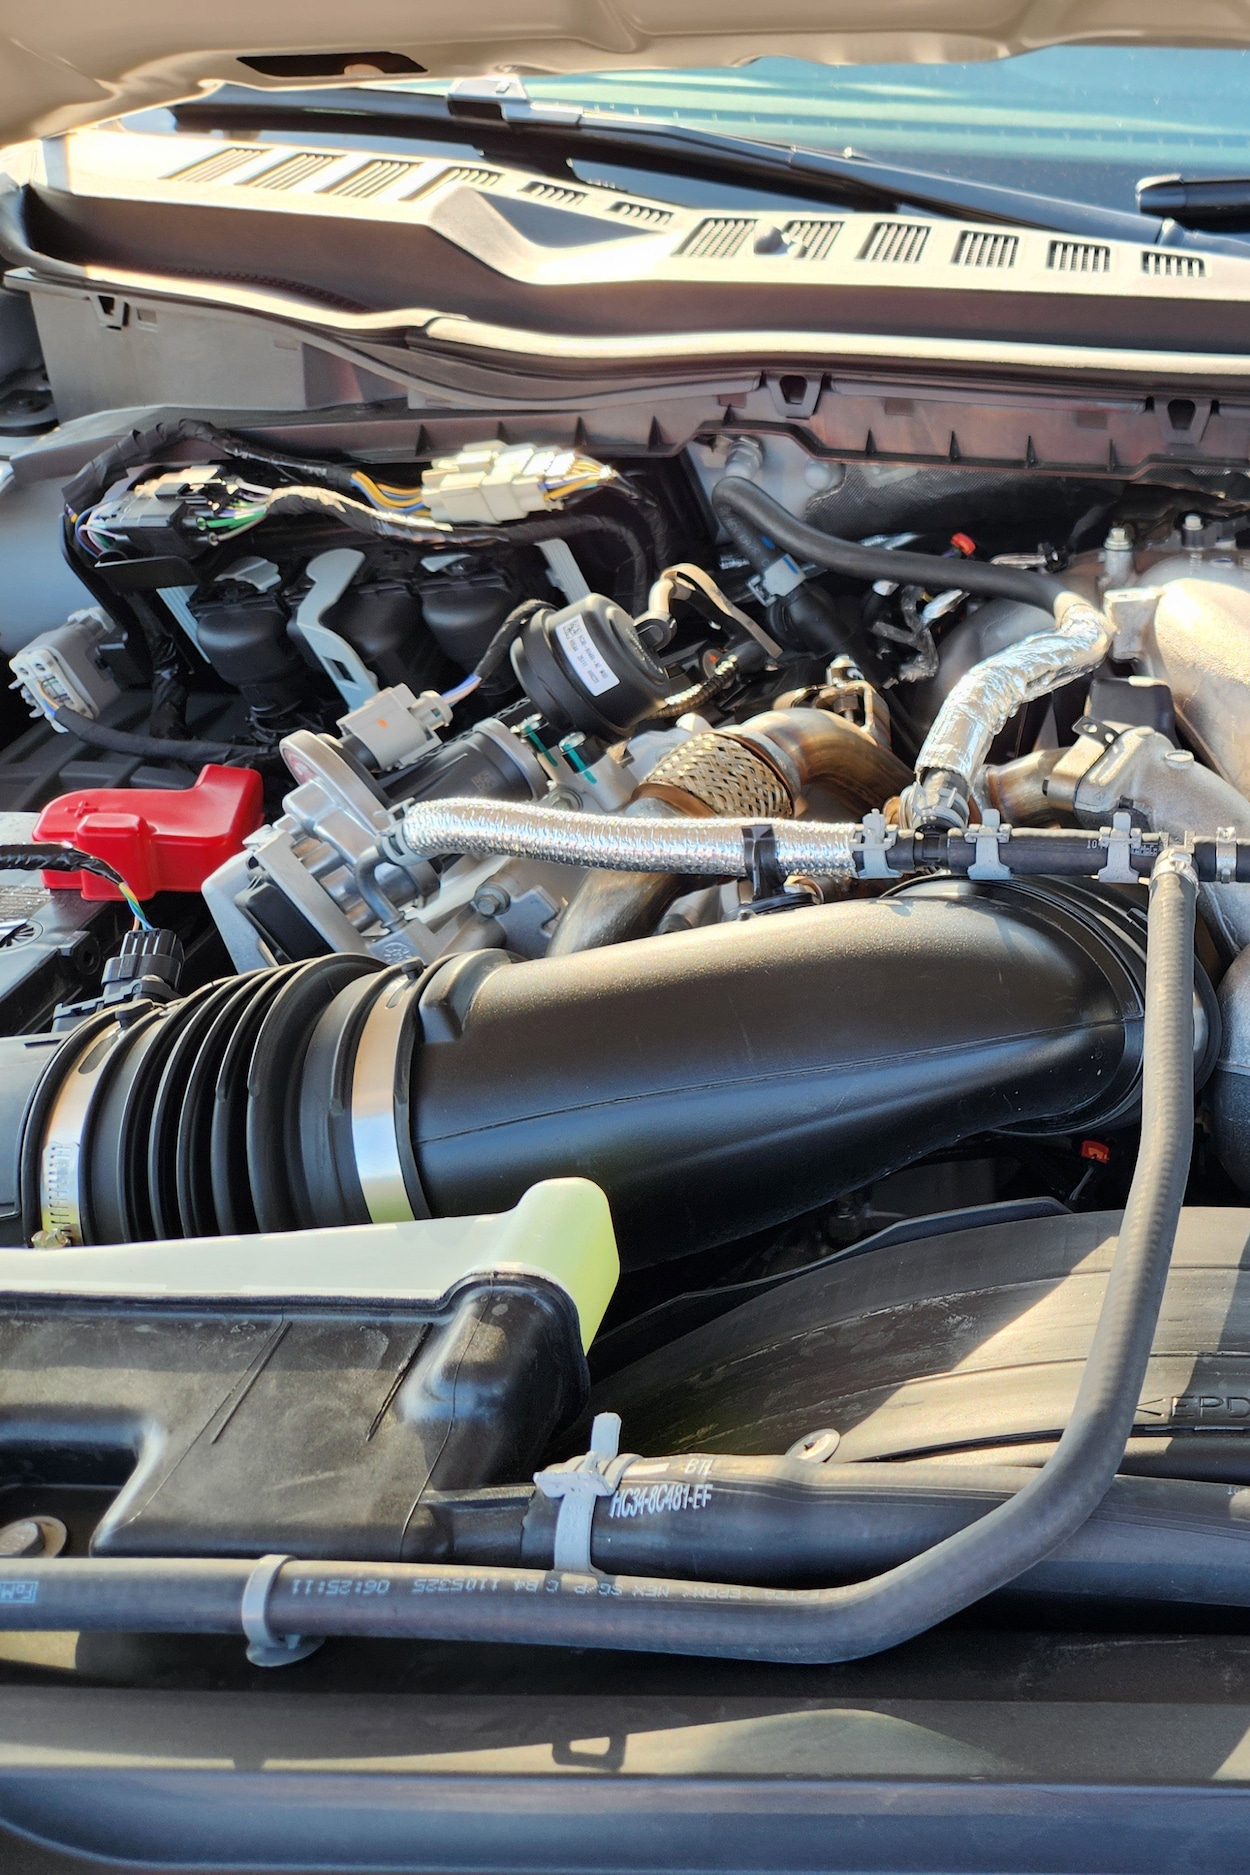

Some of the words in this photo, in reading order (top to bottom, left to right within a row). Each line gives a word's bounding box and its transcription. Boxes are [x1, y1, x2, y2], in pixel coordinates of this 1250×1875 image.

[684, 1458, 715, 1475] BTL
[608, 1483, 714, 1518] HC34-8C481-EF
[291, 1578, 391, 1596] 06:25:11
[411, 1577, 499, 1594] 1105325
[513, 1578, 540, 1593] B4
[631, 1584, 670, 1598] MEX
